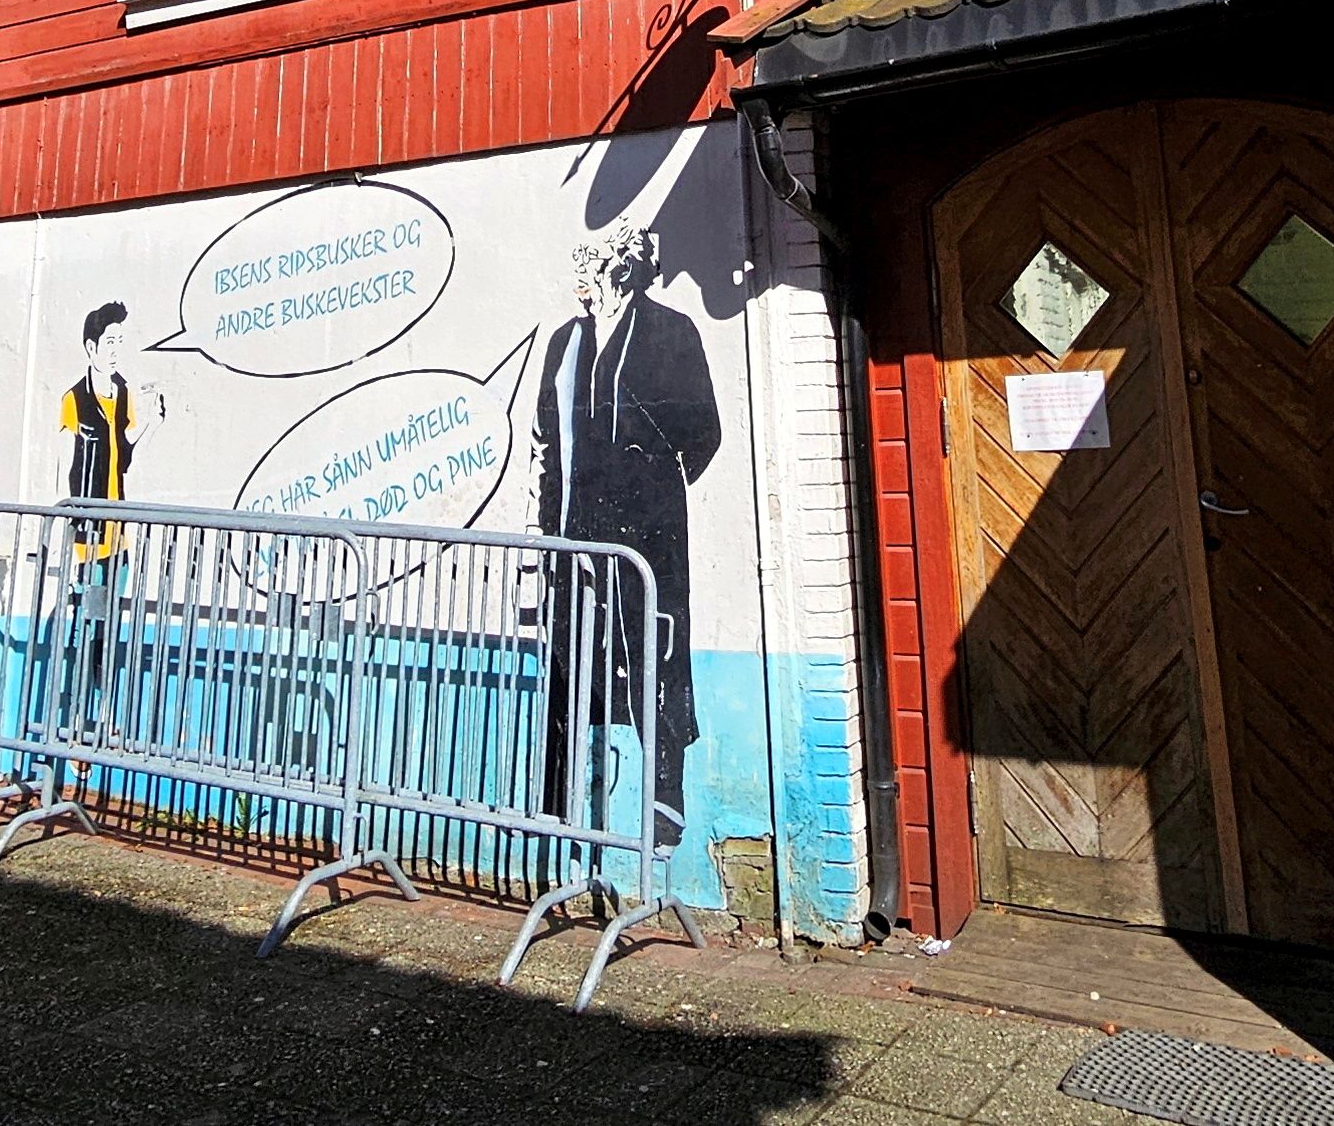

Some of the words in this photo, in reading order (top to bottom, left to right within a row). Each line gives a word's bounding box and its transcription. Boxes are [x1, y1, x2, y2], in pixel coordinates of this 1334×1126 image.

[215, 257, 272, 295] IBSENS
[278, 229, 387, 279] RIPSBUSKER
[393, 219, 421, 249] OG
[216, 302, 276, 340] ANDRE
[281, 270, 416, 325] BUSKEVEKSTER
[280, 475, 321, 512] HAR
[322, 453, 372, 493] SÅNN
[376, 396, 470, 463] UMÅTELIG
[364, 484, 408, 522] DØD
[413, 464, 443, 500] OG
[447, 436, 497, 485] PINE
